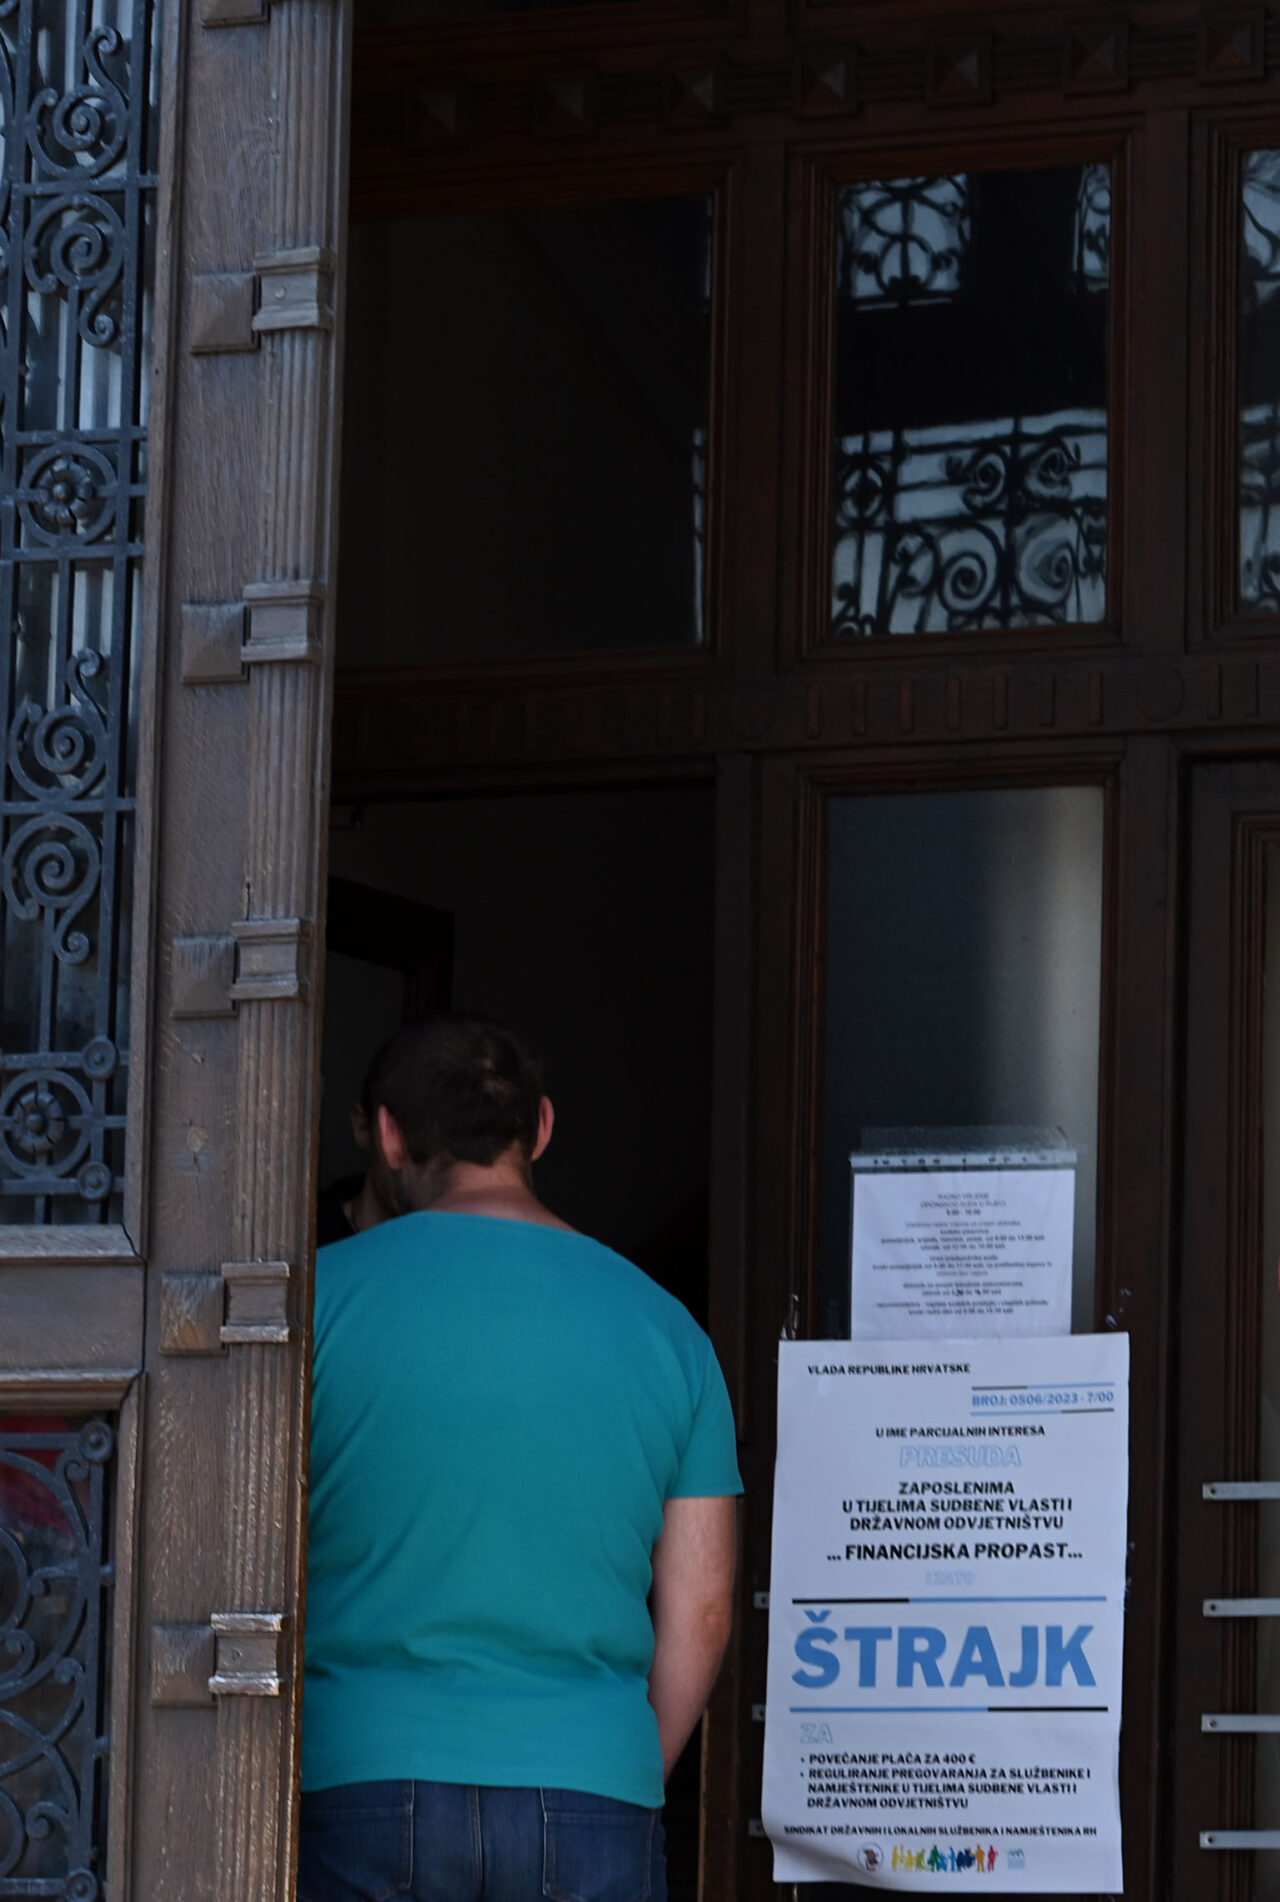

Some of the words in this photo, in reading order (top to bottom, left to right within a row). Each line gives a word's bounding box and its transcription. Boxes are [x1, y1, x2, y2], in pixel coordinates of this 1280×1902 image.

[807, 1365, 846, 1376] VLADA
[847, 1364, 910, 1375] REPUBLIKE
[911, 1363, 970, 1375] HRVATSKE
[875, 1427, 885, 1438] U
[885, 1427, 907, 1438] IME
[909, 1426, 987, 1438] PARCIJALNIH
[988, 1425, 1045, 1437] INTERESA
[900, 1446, 1021, 1467] PRESUDA
[898, 1481, 1015, 1496] ZAPOSLENIMA
[842, 1499, 853, 1514] U
[855, 1499, 927, 1513] TIJELIMA
[930, 1498, 1005, 1513] SUDBENE
[1008, 1498, 1065, 1512] VLASTI
[849, 1514, 941, 1531] DRŽAVNOM
[942, 1513, 1064, 1530] ODVJETNIŠTVU
[845, 1543, 970, 1561] FINANCIJSKA
[974, 1542, 1083, 1559] PROPAST...
[791, 1610, 1096, 1689] ŠTRAJK
[799, 1722, 834, 1744] ZA
[808, 1751, 879, 1765] POVEĆANJE
[924, 1753, 941, 1765] ZA
[942, 1753, 967, 1765] 400
[808, 1767, 889, 1780] REGULIRANJE
[891, 1768, 988, 1780] PREGOVARANJA
[989, 1767, 1007, 1780] ZA
[1008, 1766, 1085, 1780] SLUŽBENIKE
[807, 1781, 900, 1794] NAMJEŠTENIKE
[901, 1783, 911, 1794] U
[912, 1782, 966, 1794] TIJELIMA
[967, 1782, 1024, 1794] SUDBENE
[1026, 1782, 1071, 1794] VLASTI
[806, 1795, 878, 1809] DRŽAVNOM
[879, 1795, 969, 1809] ODVJETNIŠTVU
[781, 1825, 828, 1836] SINDIKAT
